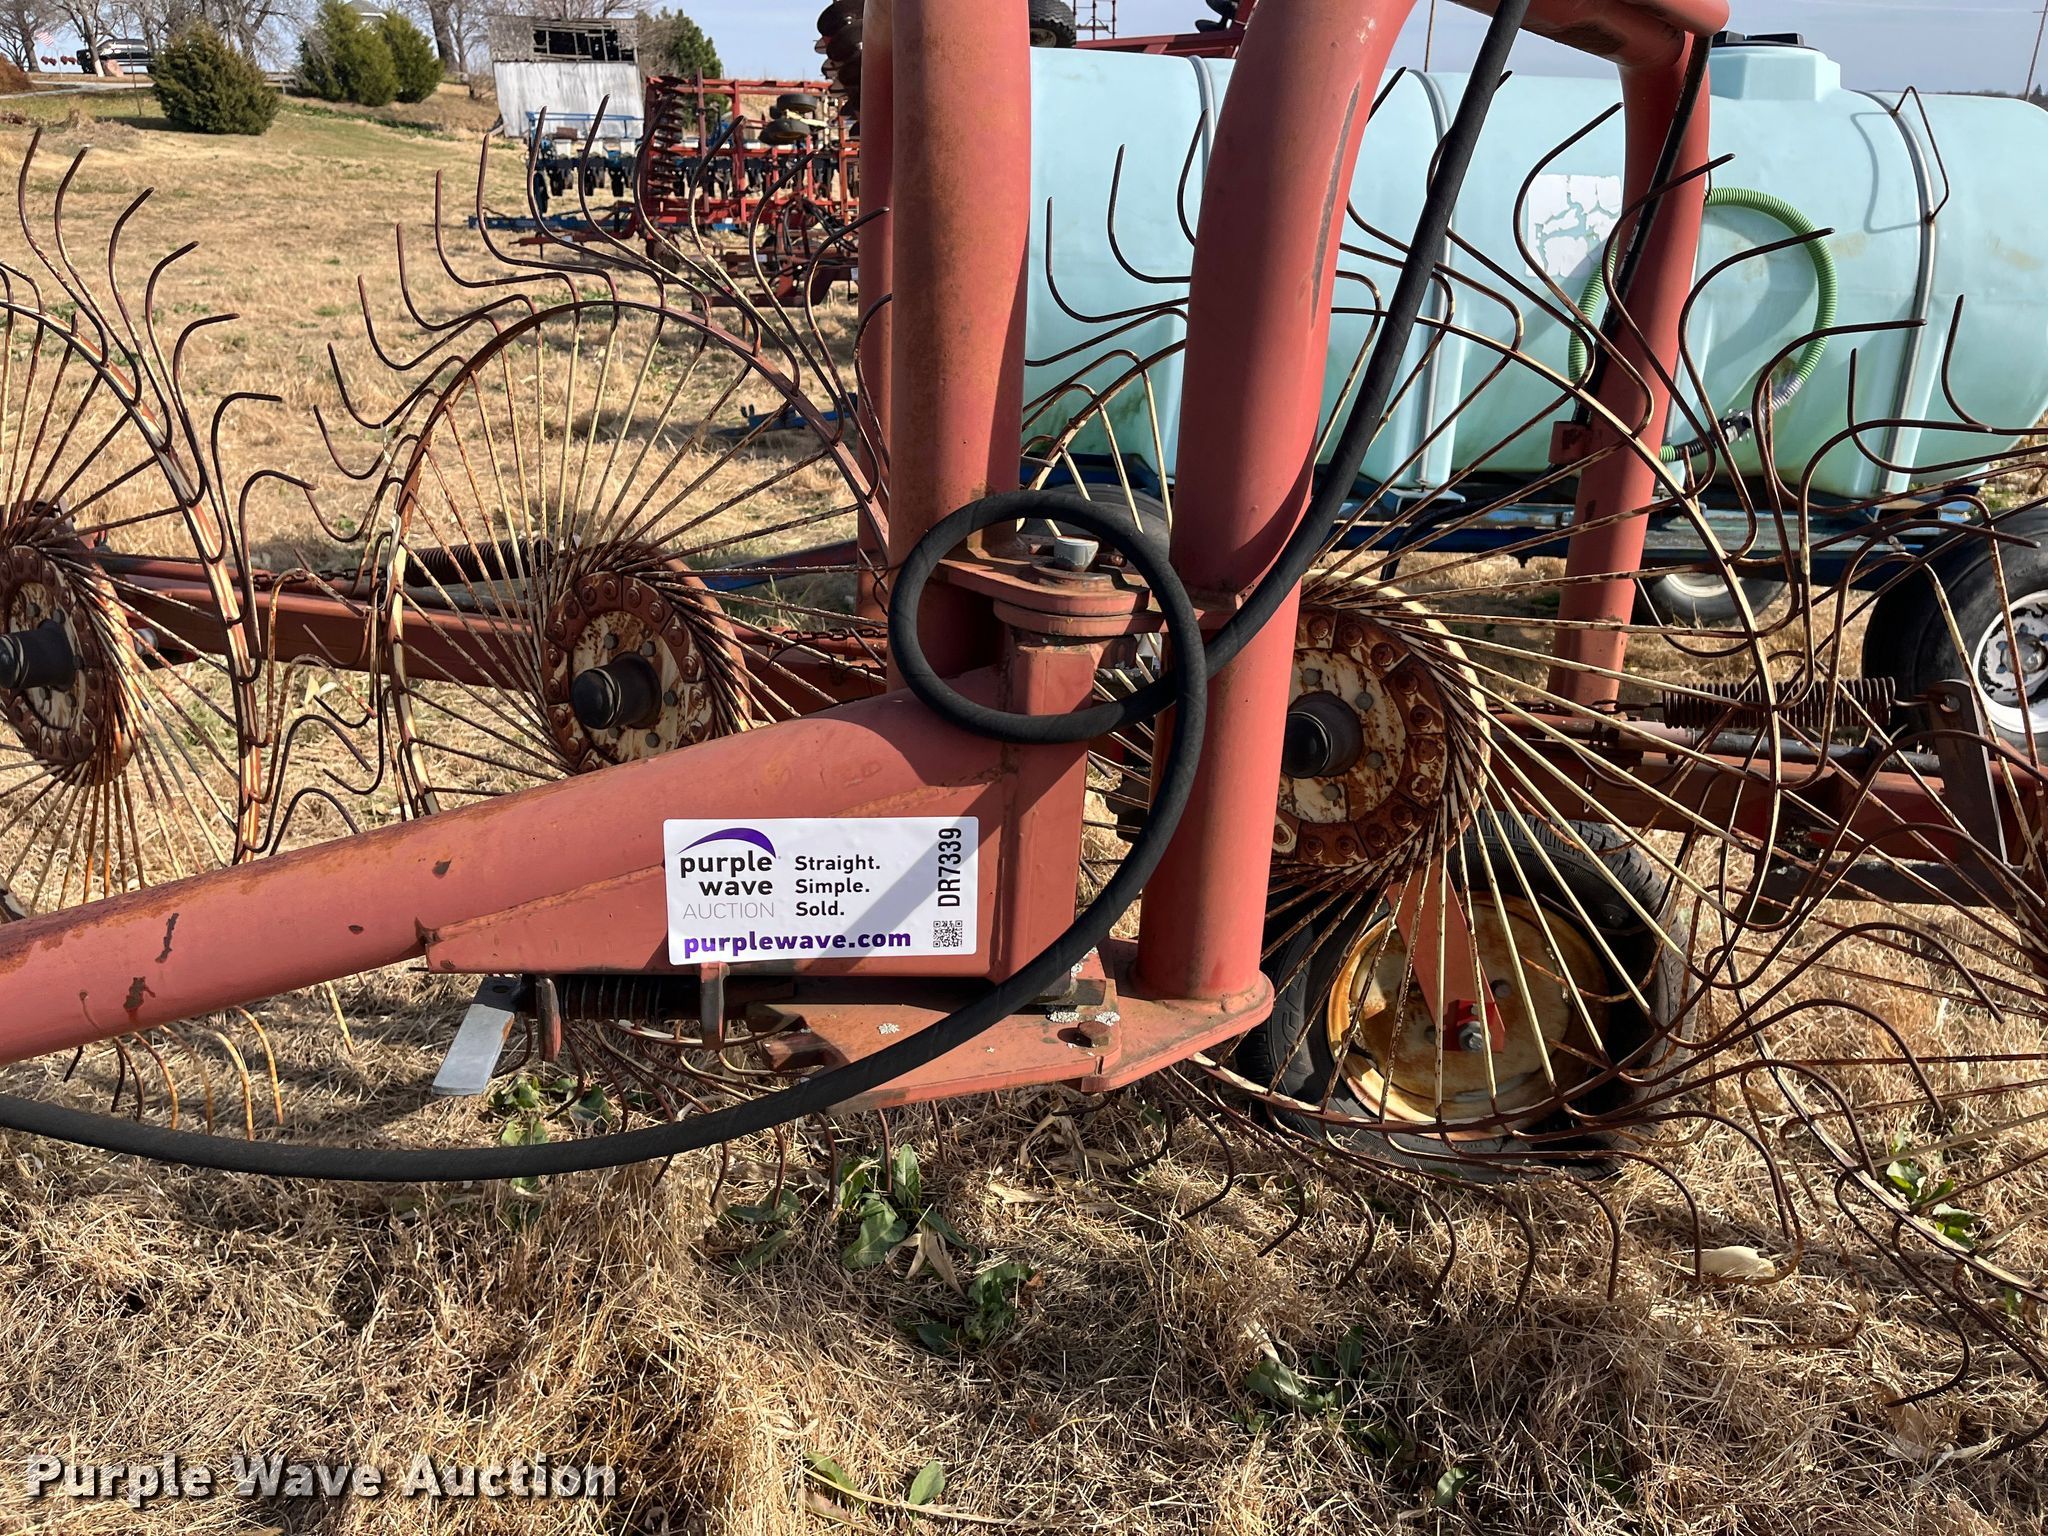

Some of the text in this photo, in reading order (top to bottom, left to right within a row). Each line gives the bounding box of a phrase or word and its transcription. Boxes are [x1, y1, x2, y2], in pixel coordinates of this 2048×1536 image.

[680, 850, 773, 878] purple
[794, 855, 881, 874] Straight.
[937, 827, 962, 907] DR7339
[699, 879, 774, 896] wave
[794, 878, 870, 897] Simple.
[682, 902, 775, 920] AUCTION
[795, 901, 845, 917] Sold.
[684, 930, 911, 959] purplewave.com
